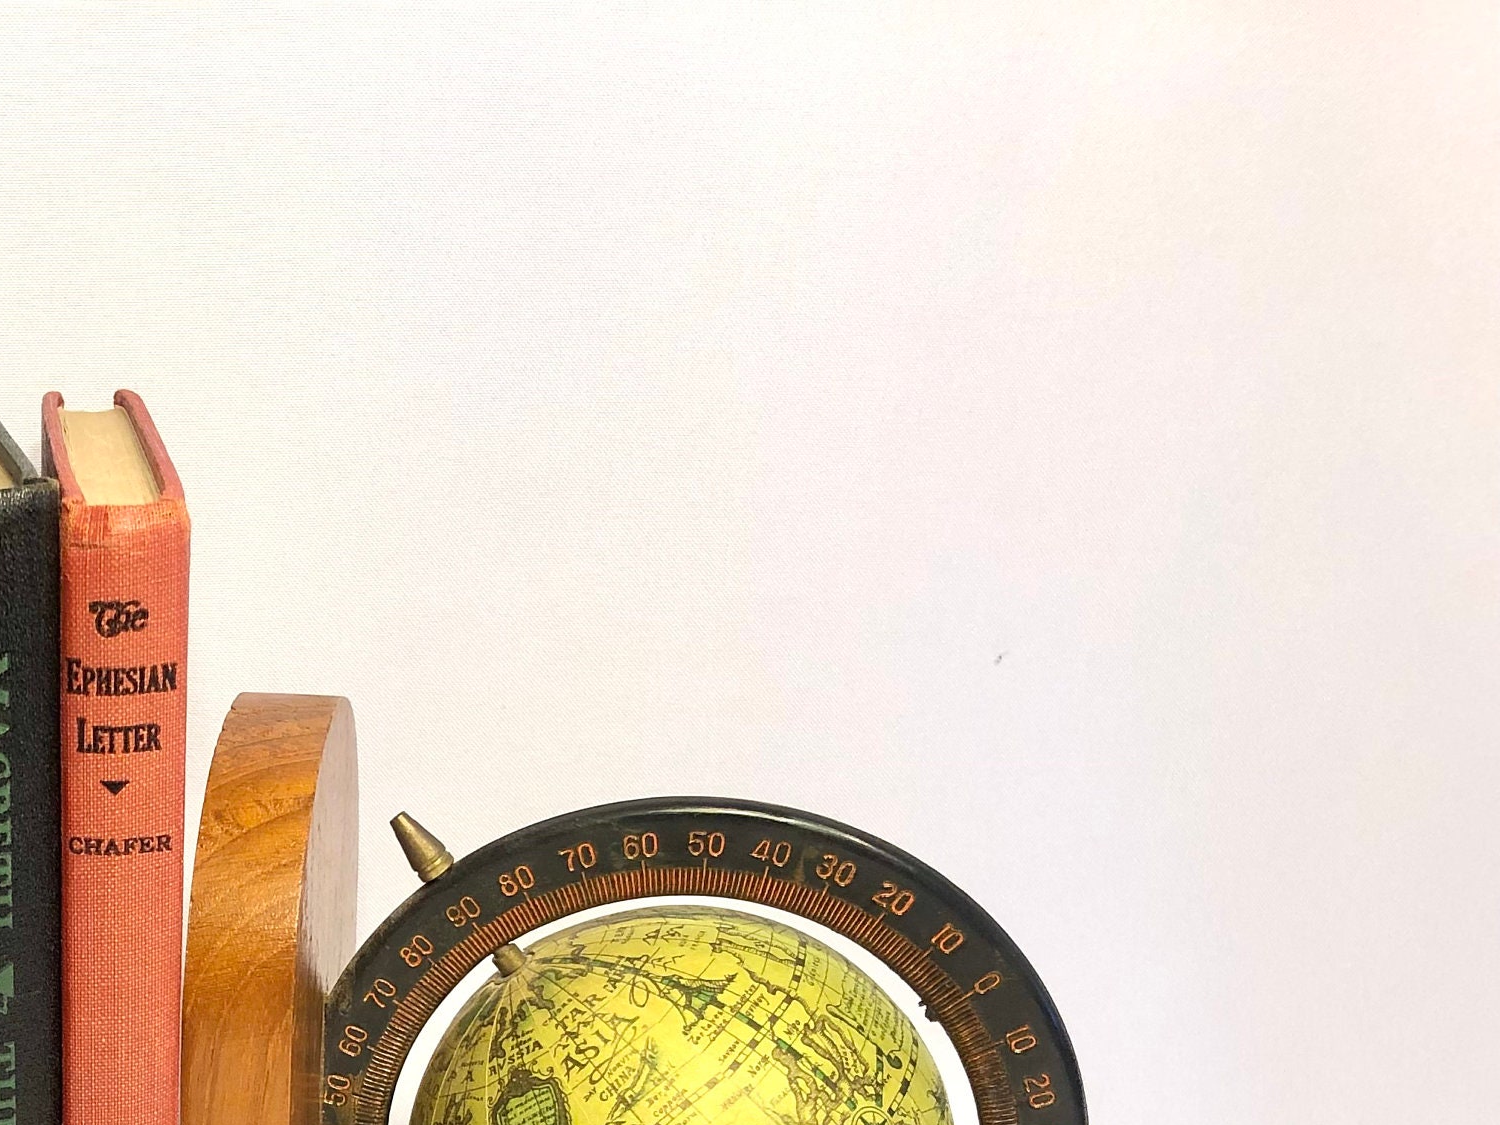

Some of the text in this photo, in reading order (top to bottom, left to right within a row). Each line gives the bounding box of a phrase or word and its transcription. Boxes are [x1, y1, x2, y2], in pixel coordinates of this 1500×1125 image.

[65, 657, 178, 697] EPHESIAN
[76, 717, 162, 755] LETTER
[68, 835, 173, 858] CHAFER
[558, 842, 597, 872] 70
[622, 831, 658, 859] 60
[687, 831, 725, 858] 50
[750, 839, 792, 868] 40
[498, 864, 536, 897] 80
[815, 853, 858, 888] 30
[871, 880, 916, 916] 20
[399, 935, 433, 968] 80
[930, 922, 964, 955] 10
[363, 977, 399, 1009] 70
[973, 970, 1001, 995] 0
[338, 1024, 369, 1058] 60
[1004, 1023, 1037, 1054] 10
[599, 1065, 637, 1102] CHINA
[1022, 1073, 1056, 1109] 20
